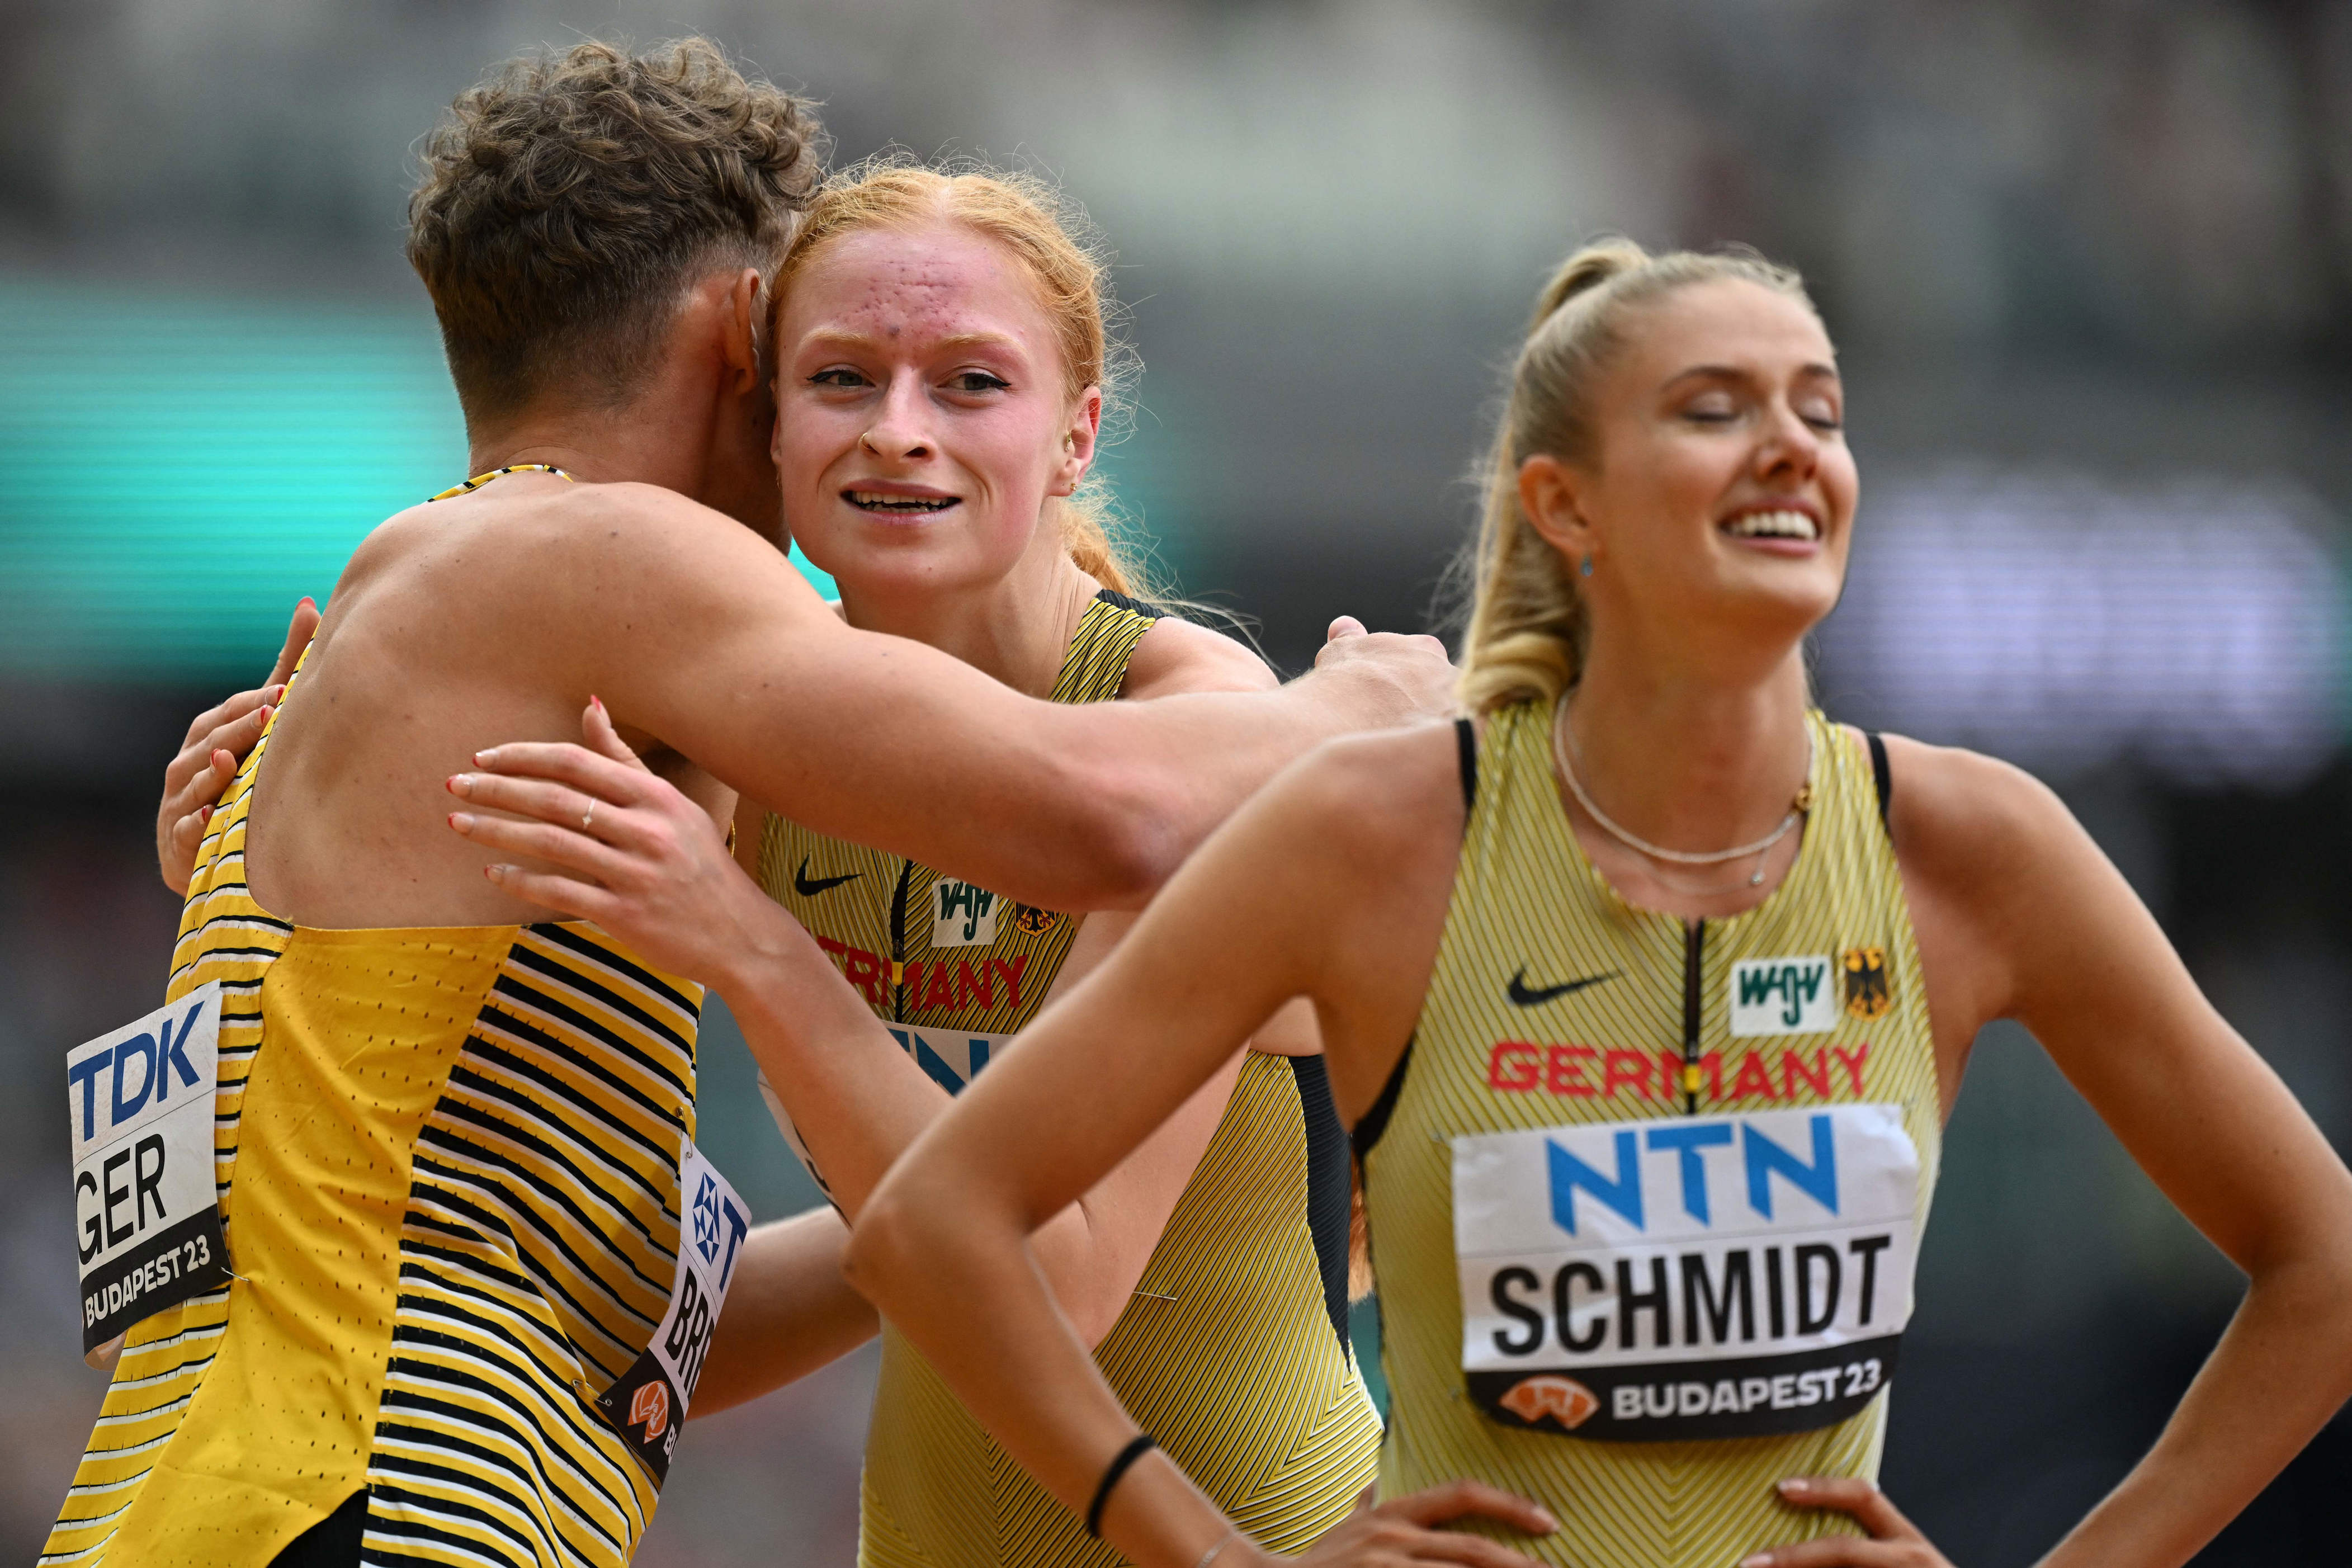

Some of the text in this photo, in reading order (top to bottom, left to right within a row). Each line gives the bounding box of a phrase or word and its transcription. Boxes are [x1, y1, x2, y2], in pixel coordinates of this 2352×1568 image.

[804, 926, 1028, 1011] RMANY
[69, 1000, 205, 1142] TDK
[1488, 1041, 1869, 1101] GERMANY
[74, 1133, 167, 1265] GER
[1544, 1114, 1840, 1238] NTN
[85, 1234, 211, 1329] BUDAPEST 23
[1489, 1234, 1891, 1357] SCHMIDT
[1612, 1358, 1883, 1420] BUDAPEST 23
